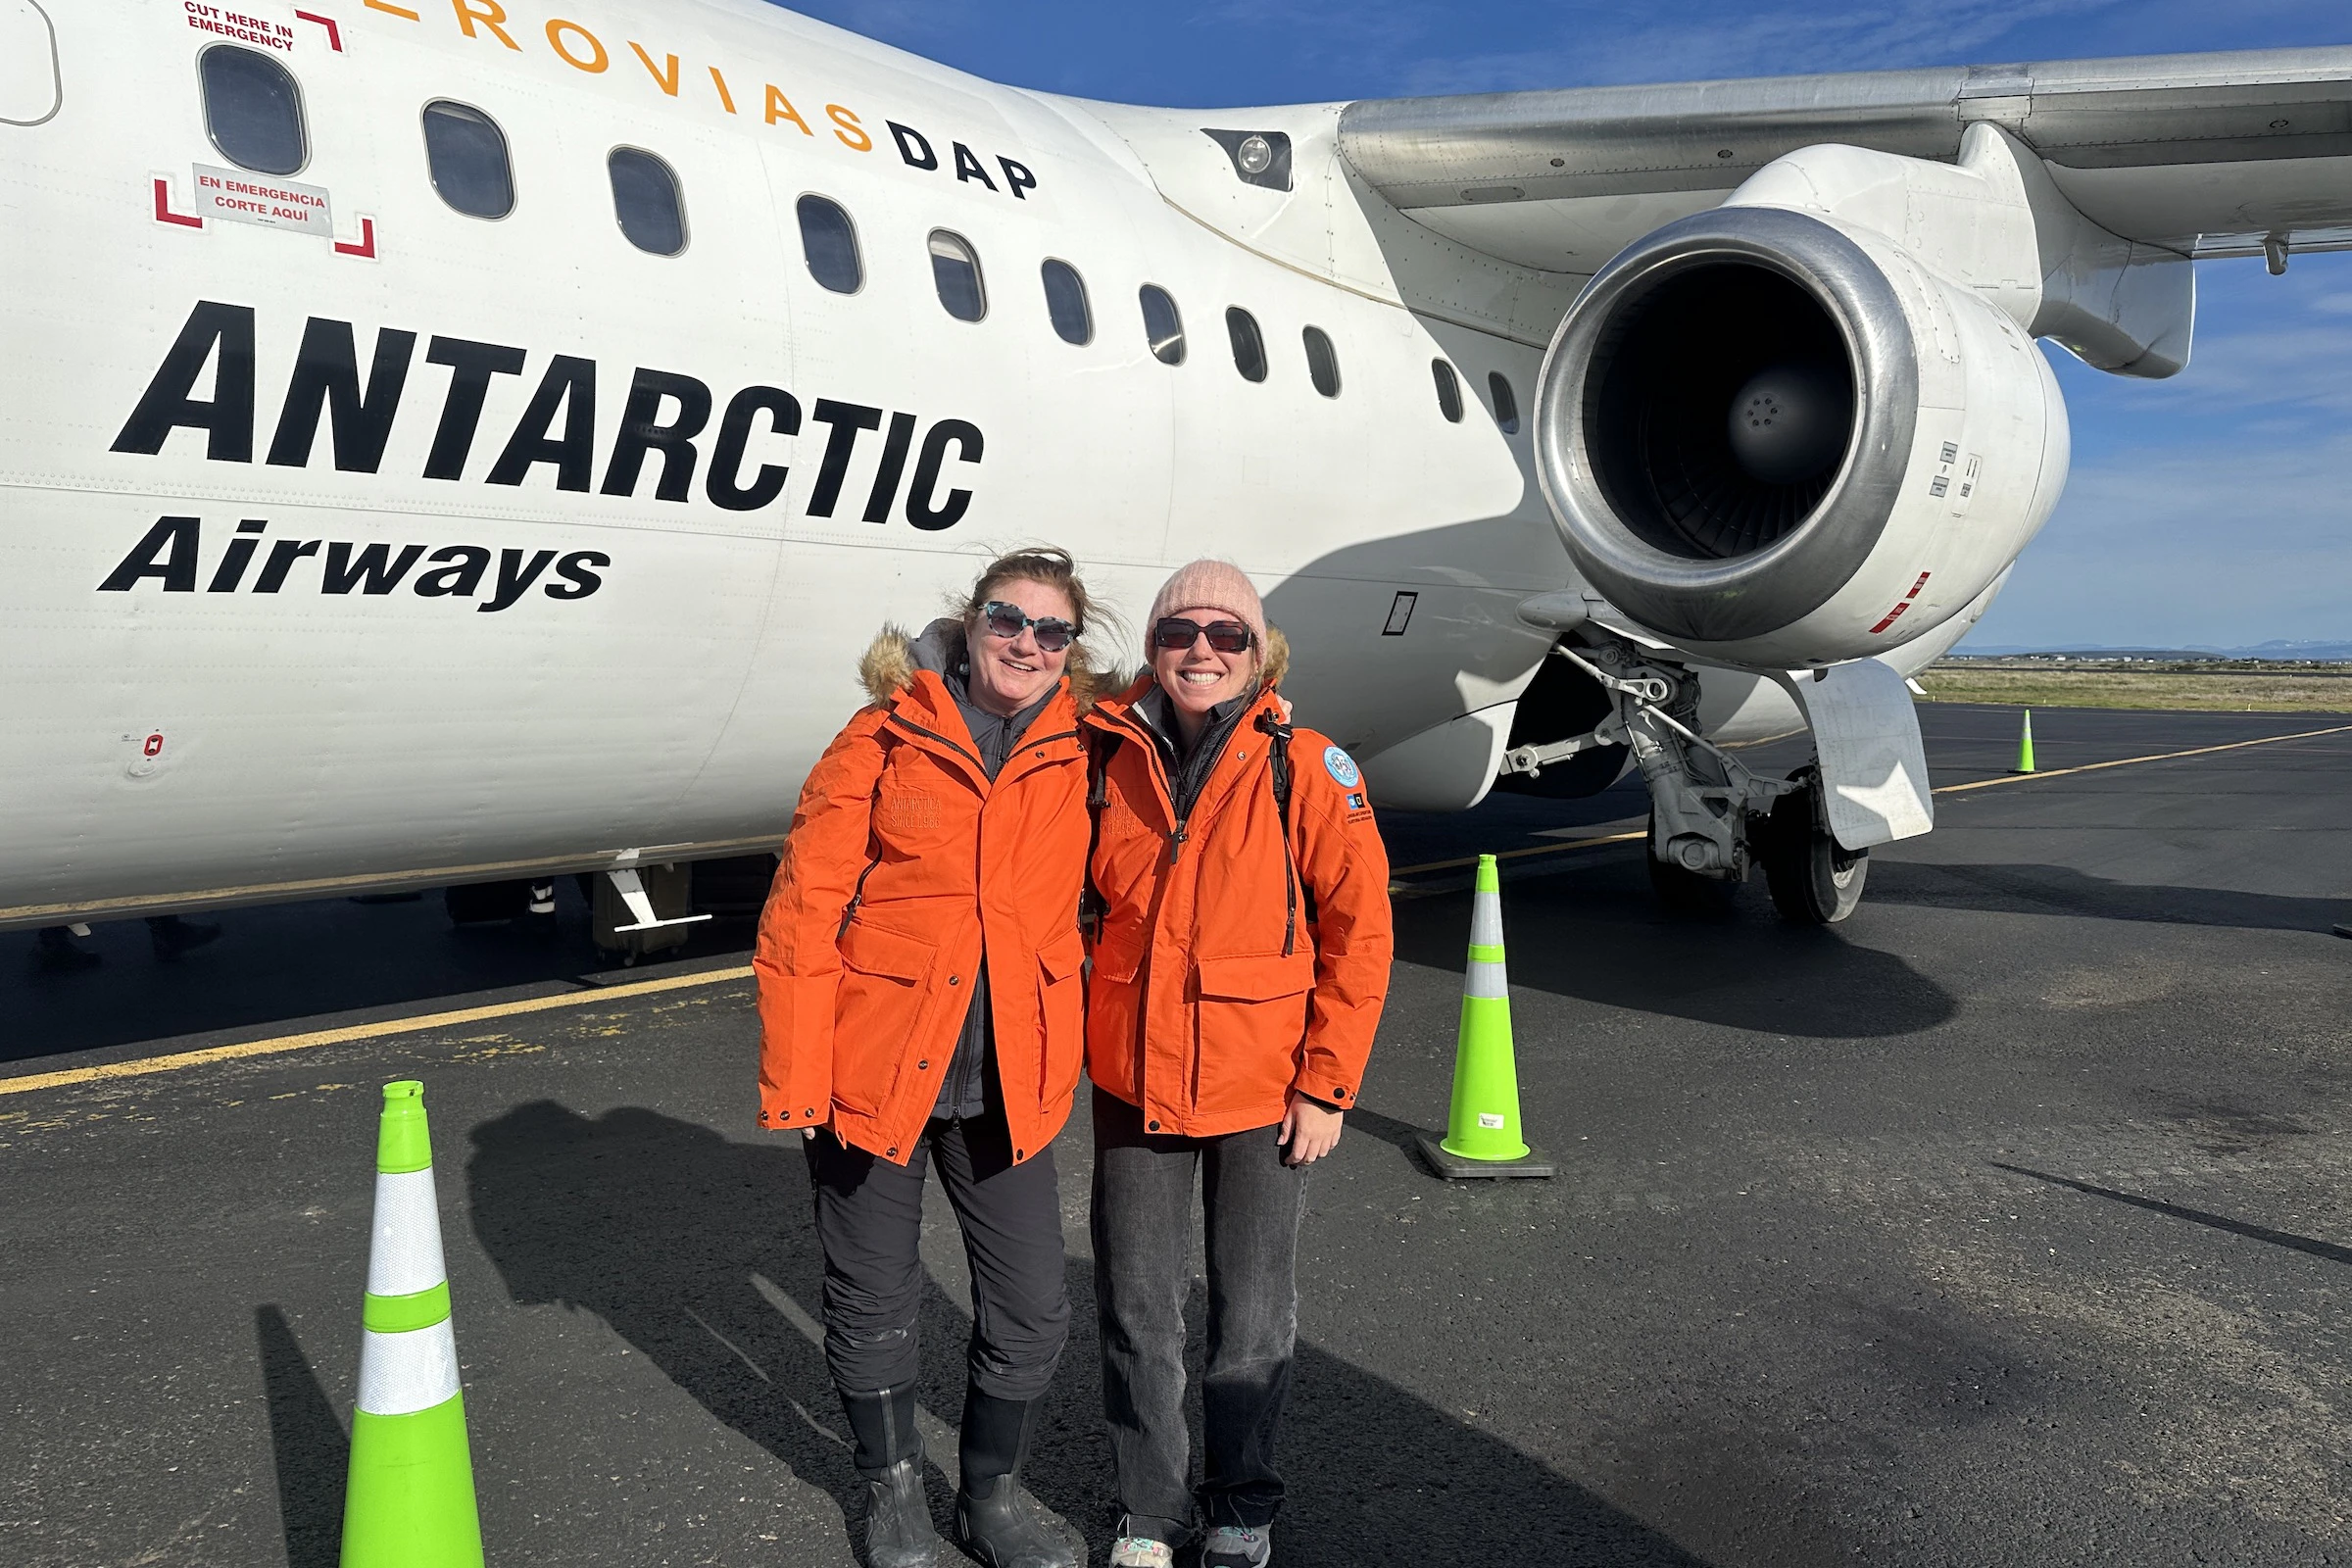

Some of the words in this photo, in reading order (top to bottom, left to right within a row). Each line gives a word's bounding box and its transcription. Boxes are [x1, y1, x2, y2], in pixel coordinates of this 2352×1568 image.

[184, 1, 220, 20] CUT
[224, 11, 271, 33] HERE
[274, 24, 294, 39] IN
[187, 15, 293, 52] EMERGENCY
[363, 0, 873, 153] ROVIAS
[885, 119, 1038, 201] DAP
[199, 175, 221, 189] EN
[225, 179, 325, 209] EMERGENCIA
[215, 196, 268, 215] CORTE
[271, 206, 309, 222] AQUÍ
[108, 299, 985, 532] ANTARCTIC
[95, 515, 612, 612] Airways
[890, 795, 941, 812] ANTARCTICA
[890, 814, 916, 829] SINCE
